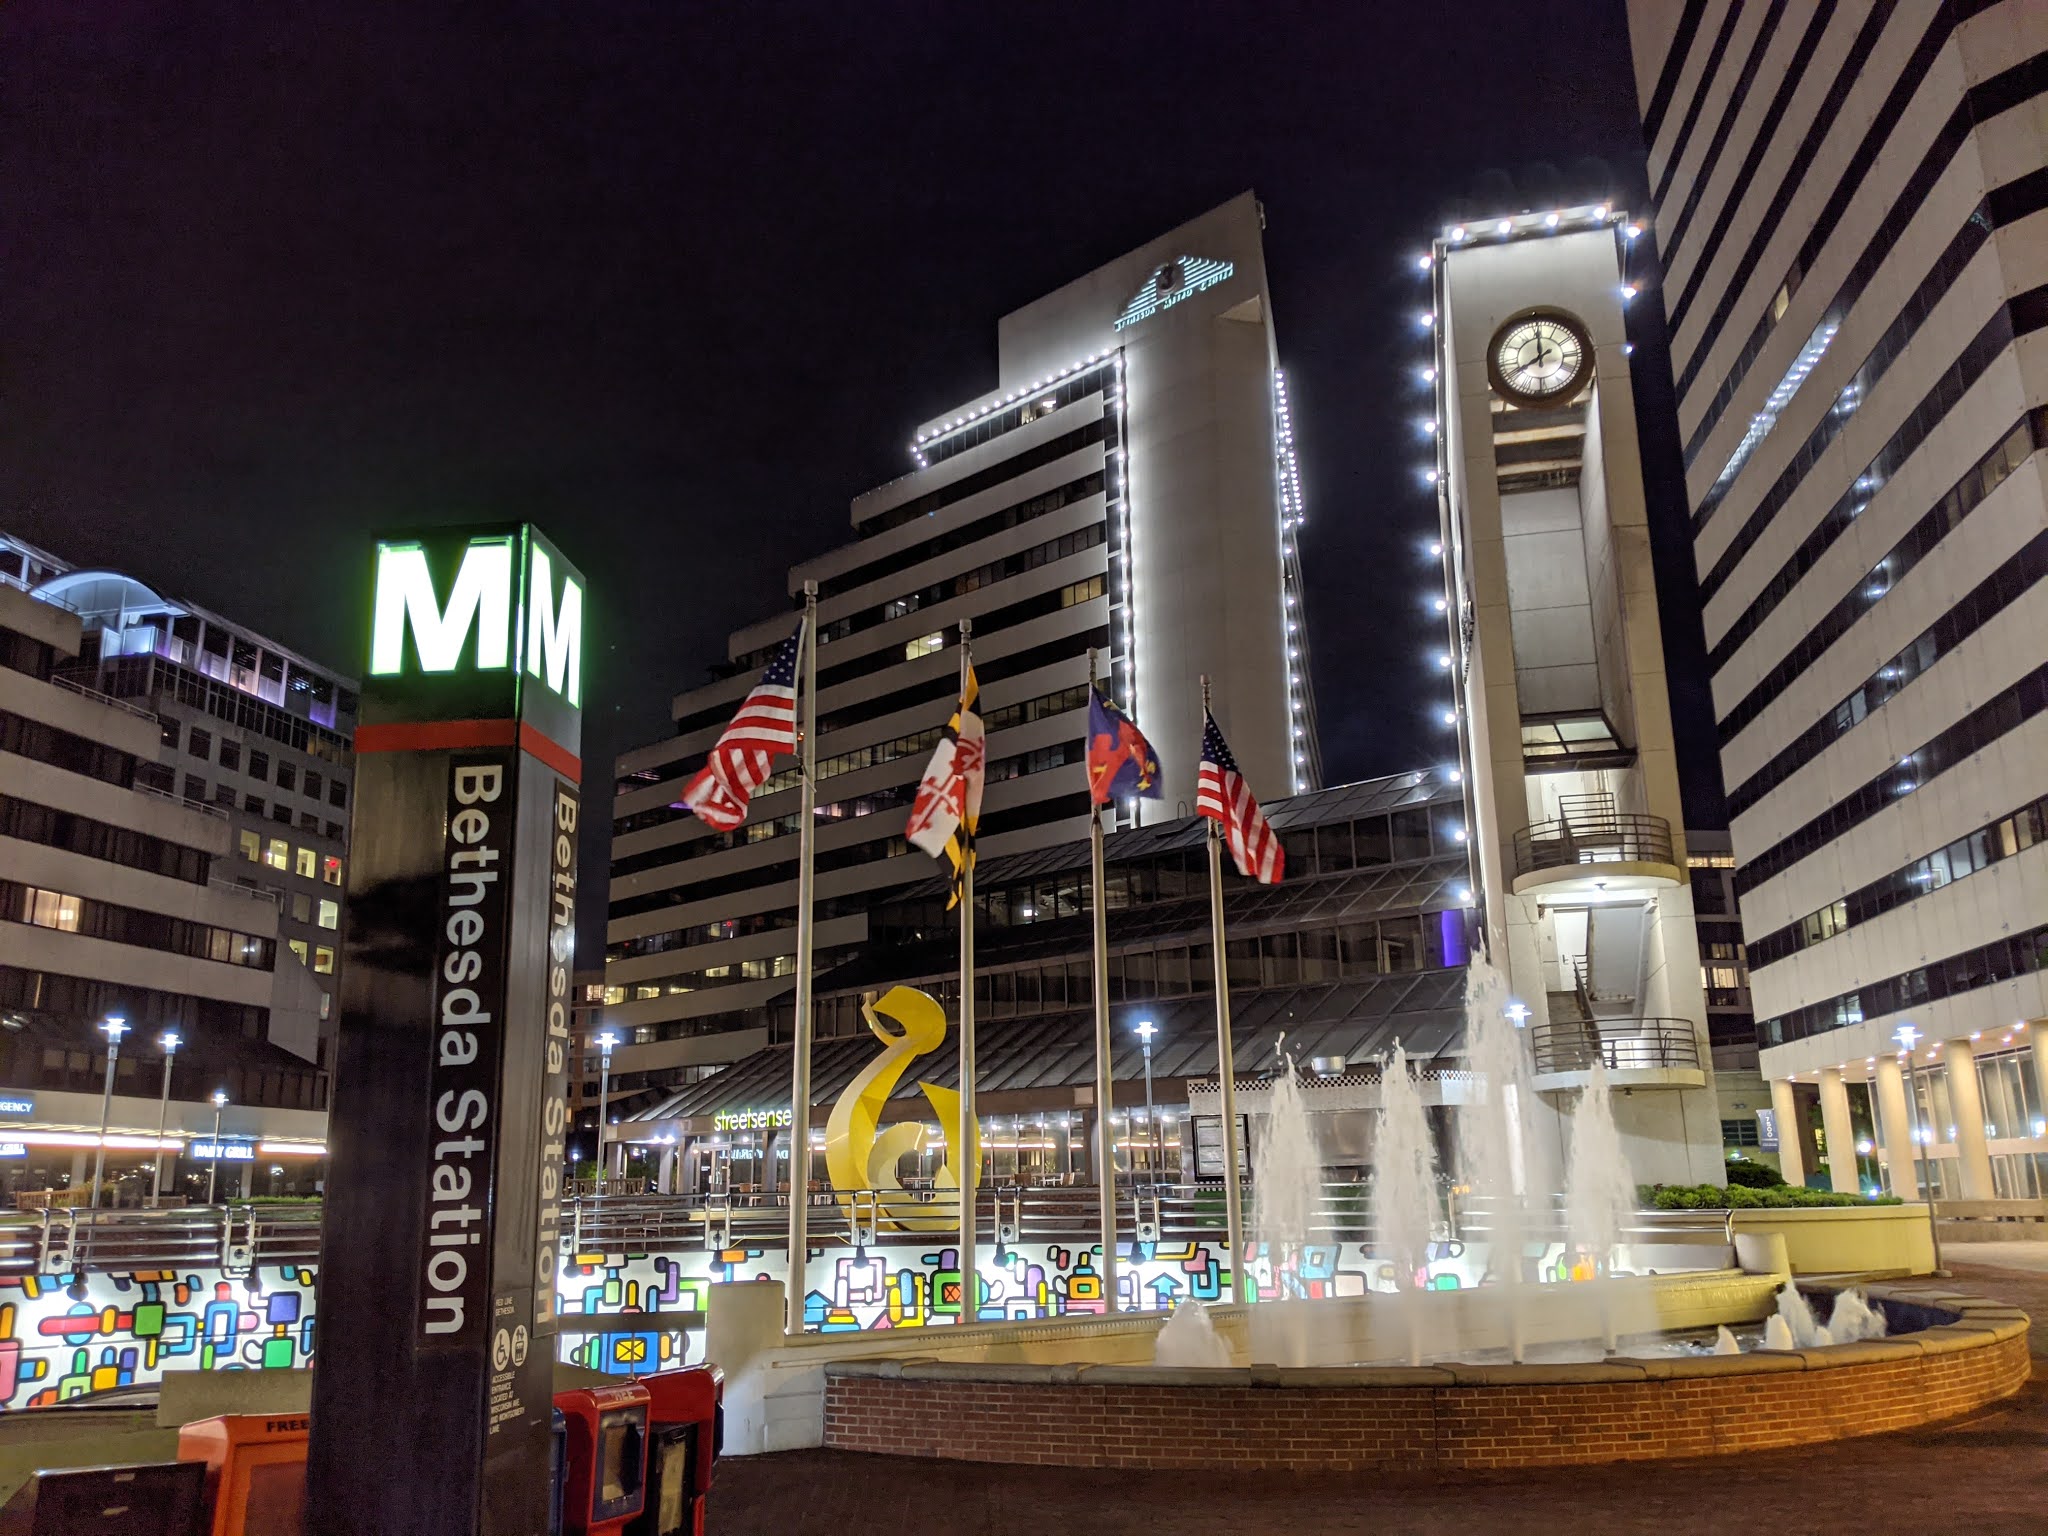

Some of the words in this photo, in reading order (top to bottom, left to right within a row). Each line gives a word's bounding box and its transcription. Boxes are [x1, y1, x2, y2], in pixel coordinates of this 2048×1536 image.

[371, 536, 513, 675] M
[527, 541, 583, 709] M
[439, 764, 502, 1067] Bethesda
[547, 791, 577, 1075] Bethesda
[714, 1108, 792, 1132] streetsense
[1765, 1116, 1773, 1138] 7500
[425, 1089, 488, 1334] Station
[537, 1096, 565, 1324] Station
[266, 1419, 309, 1432] FREE
